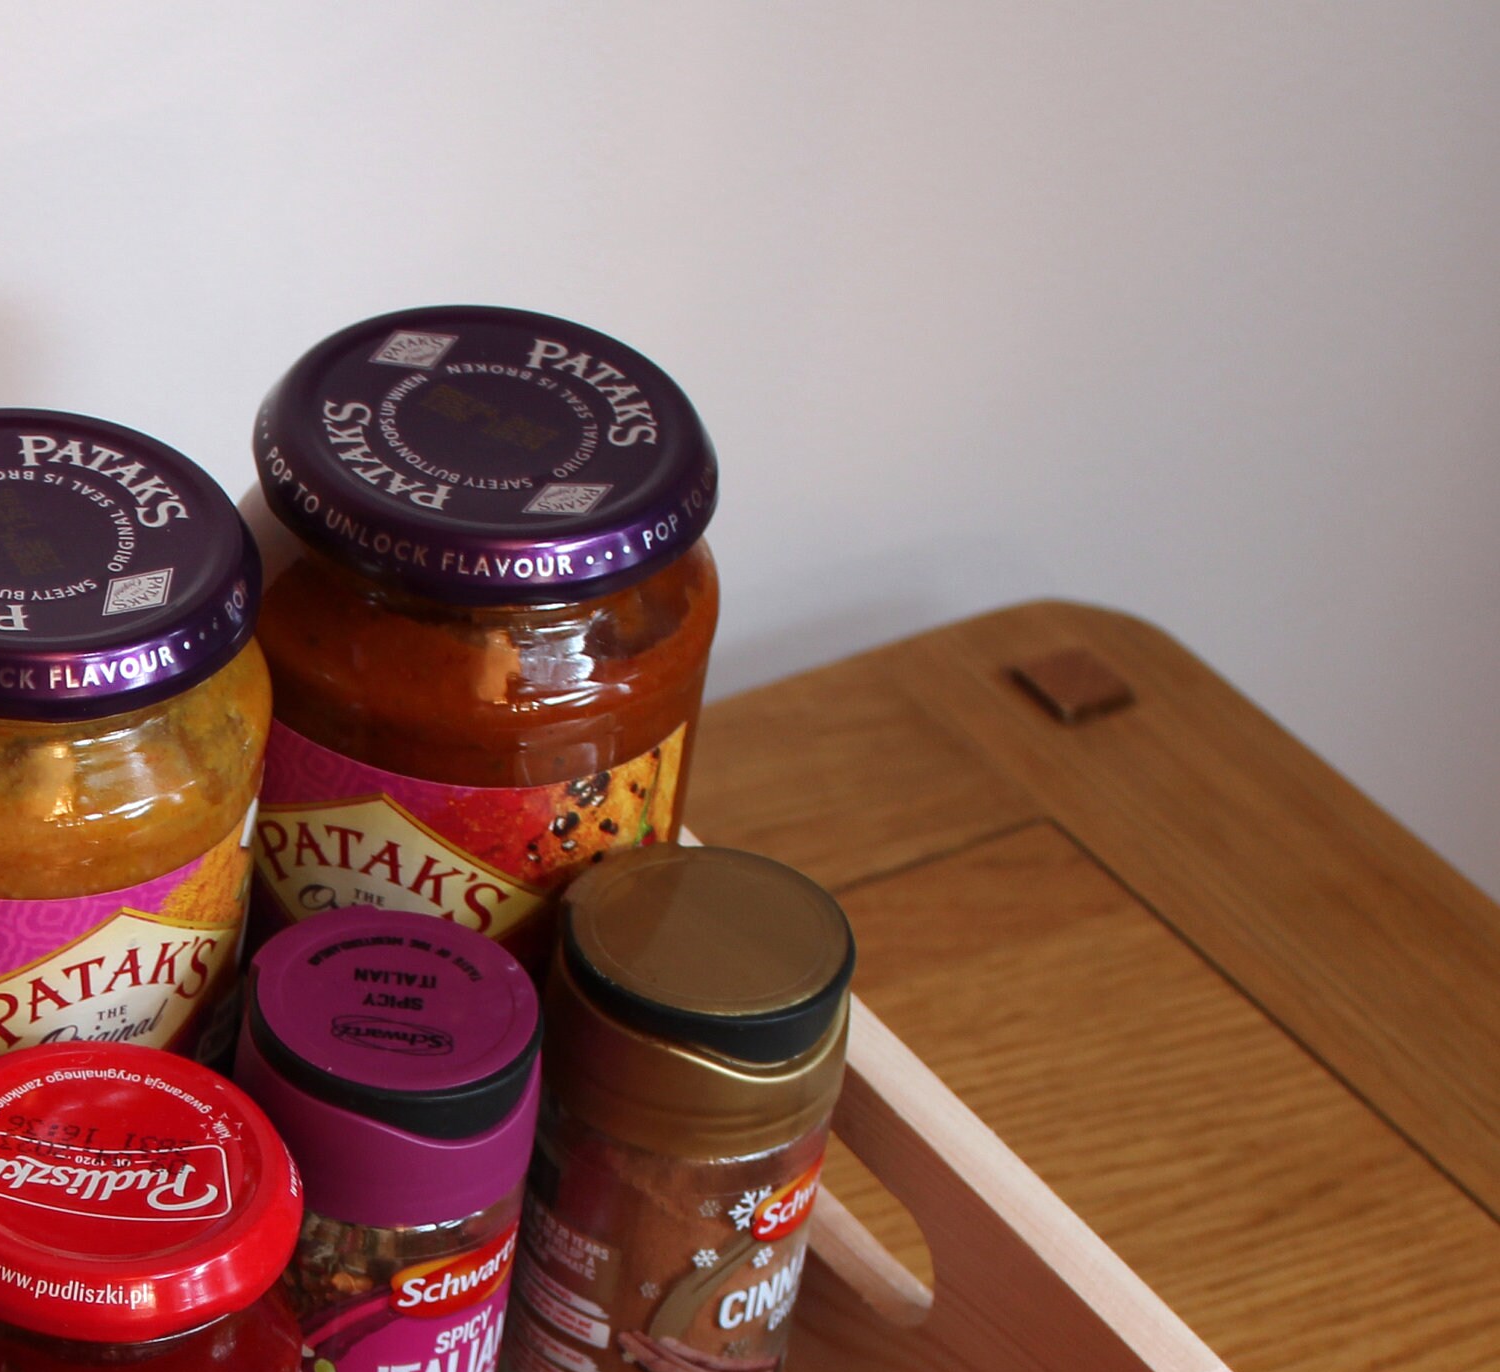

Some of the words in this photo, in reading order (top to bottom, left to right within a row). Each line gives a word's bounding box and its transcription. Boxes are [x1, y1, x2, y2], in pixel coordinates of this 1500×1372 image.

[446, 363, 532, 380] BROKEN
[538, 378, 558, 390] IS
[387, 373, 429, 401] WHEN
[527, 339, 658, 446] PATAK'S
[380, 400, 396, 416] UP
[560, 388, 594, 419] SEAL
[380, 417, 404, 448] POPS
[323, 400, 452, 511] PATAK'S
[553, 423, 598, 478] ORIGINAL
[18, 435, 189, 528] PATAK'S
[44, 473, 63, 485] IS
[400, 451, 460, 484] BUTTON
[73, 485, 114, 508] SEAL
[463, 477, 533, 490] SAFETY
[266, 446, 292, 484] POP
[294, 483, 320, 513] TO
[325, 508, 429, 567] UNLOCK
[442, 552, 573, 578] FLAVOUR
[107, 509, 134, 572] ORIGINAL
[642, 513, 678, 550] POP
[31, 579, 98, 601] SAFETY
[112, 576, 164, 609] PATAK'S
[49, 646, 174, 690] FLAVOUR
[257, 819, 511, 932] PATAK'S
[353, 888, 387, 907] THE
[354, 968, 438, 989] ITALIAN
[97, 1005, 128, 1021] THE
[362, 992, 425, 1011] SPICY
[340, 1024, 445, 1048] Schwartz
[45, 1068, 141, 1083] oryginalnego
[212, 1120, 232, 1139] klik
[434, 1305, 492, 1354] SPICY
